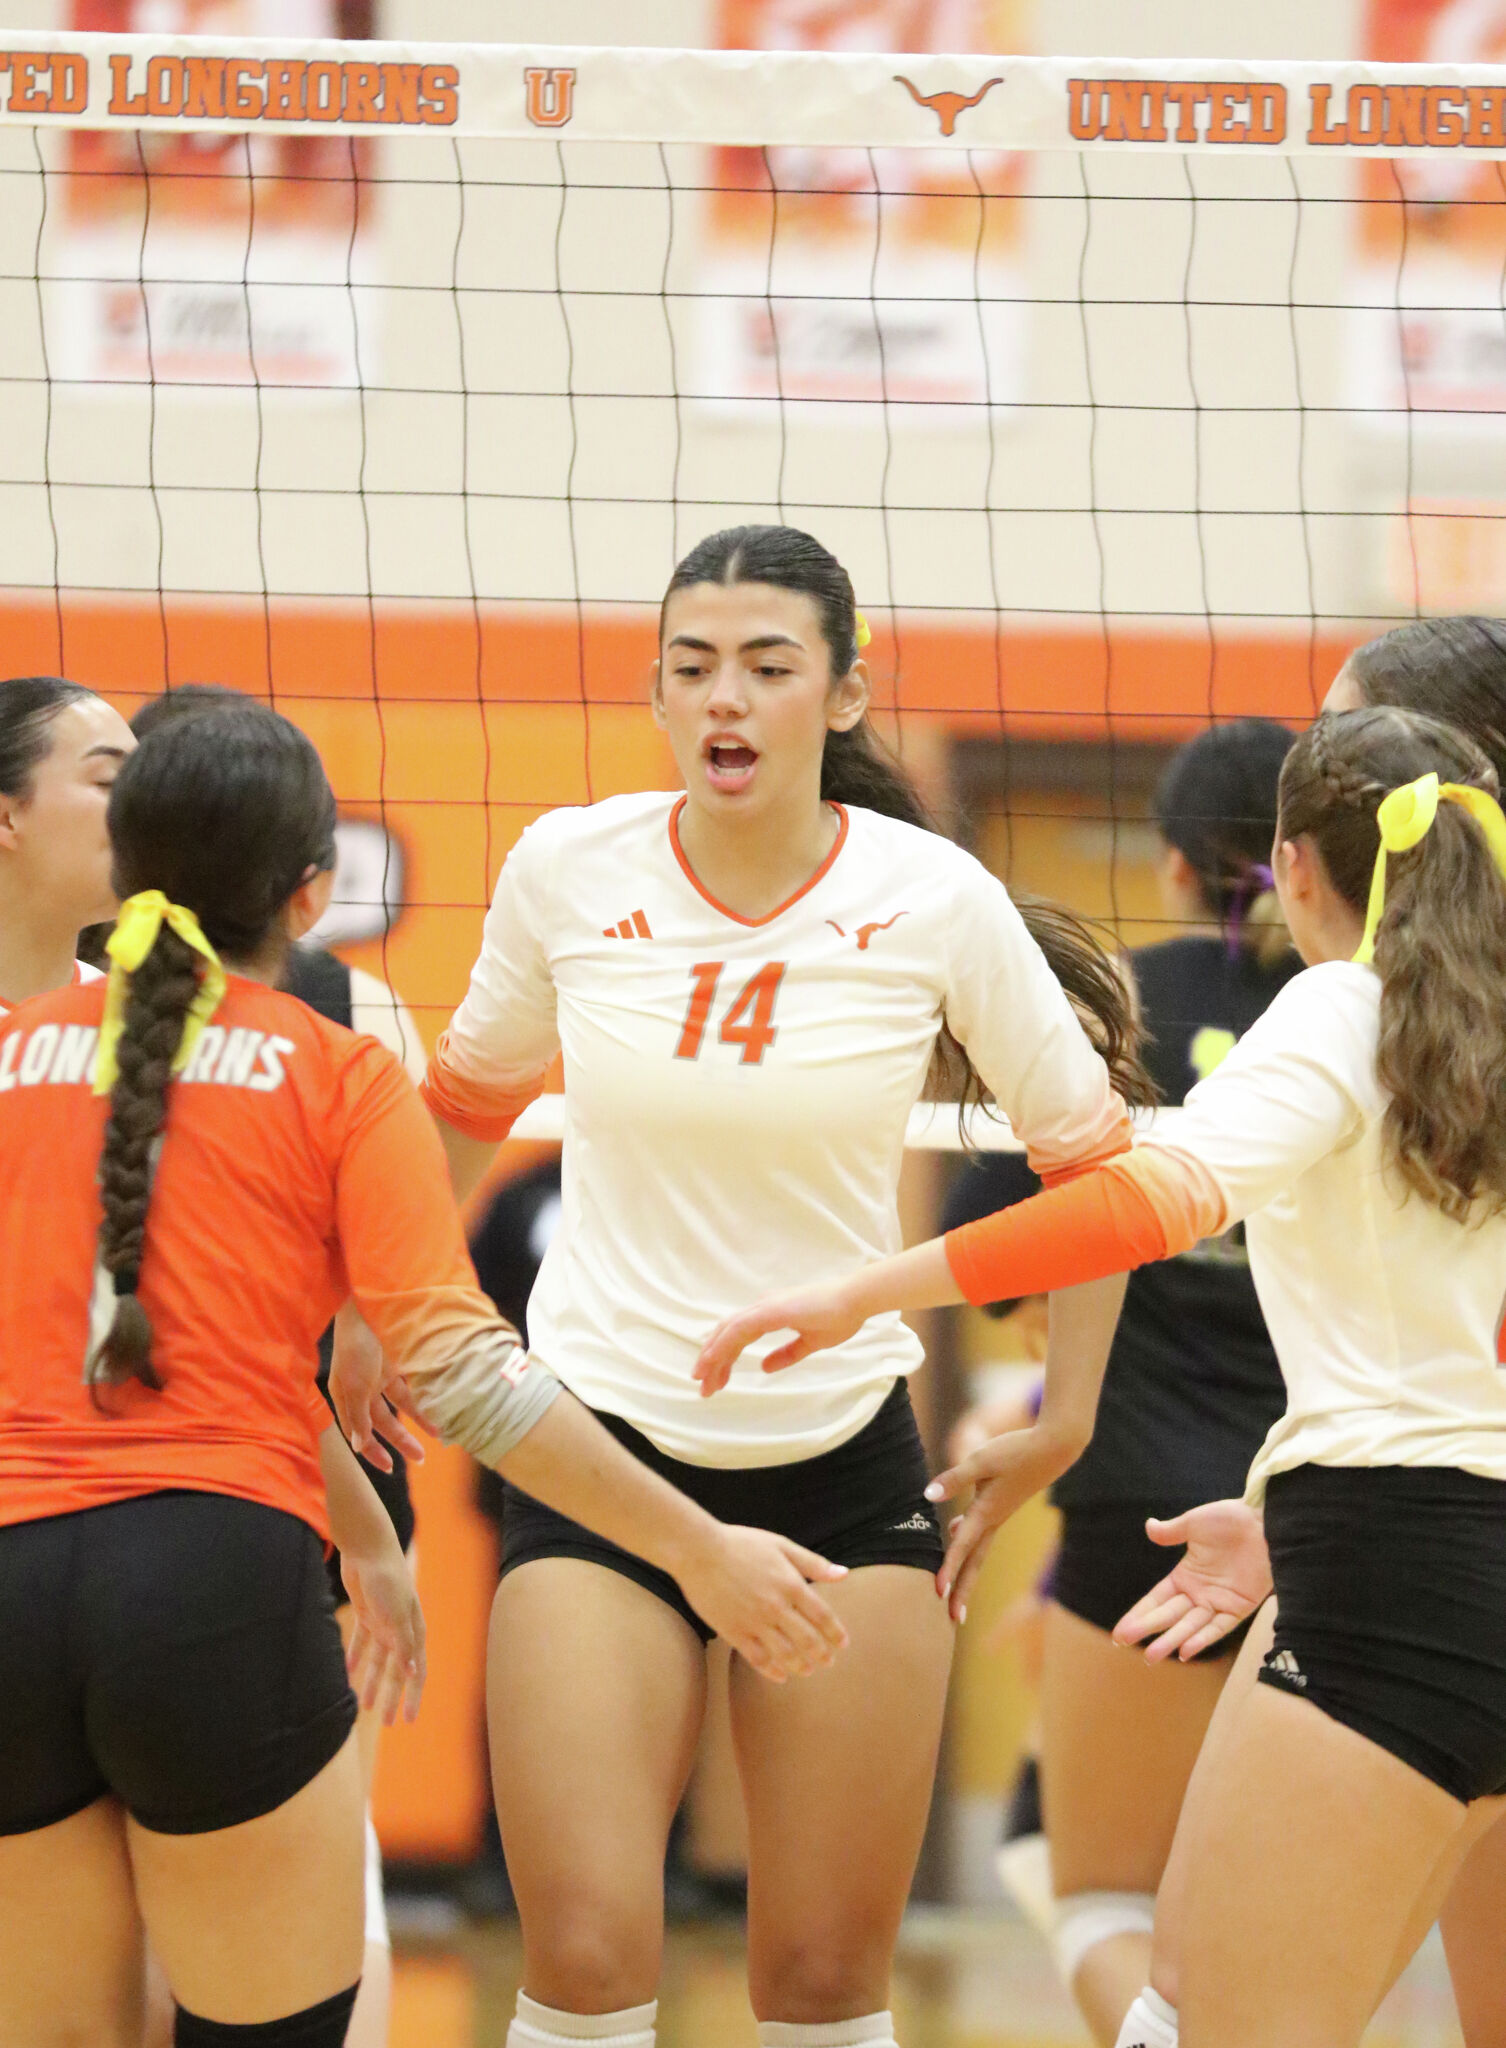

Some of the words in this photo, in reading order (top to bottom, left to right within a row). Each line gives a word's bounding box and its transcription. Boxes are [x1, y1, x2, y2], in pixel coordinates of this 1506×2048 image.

[0, 51, 88, 114] ED
[108, 54, 460, 126] LONGHORNS
[524, 67, 577, 127] U
[1067, 78, 1287, 145] UNITED
[1307, 83, 1506, 148] LONGH
[672, 960, 789, 1066] 14
[0, 1023, 295, 1092] LONRNS
